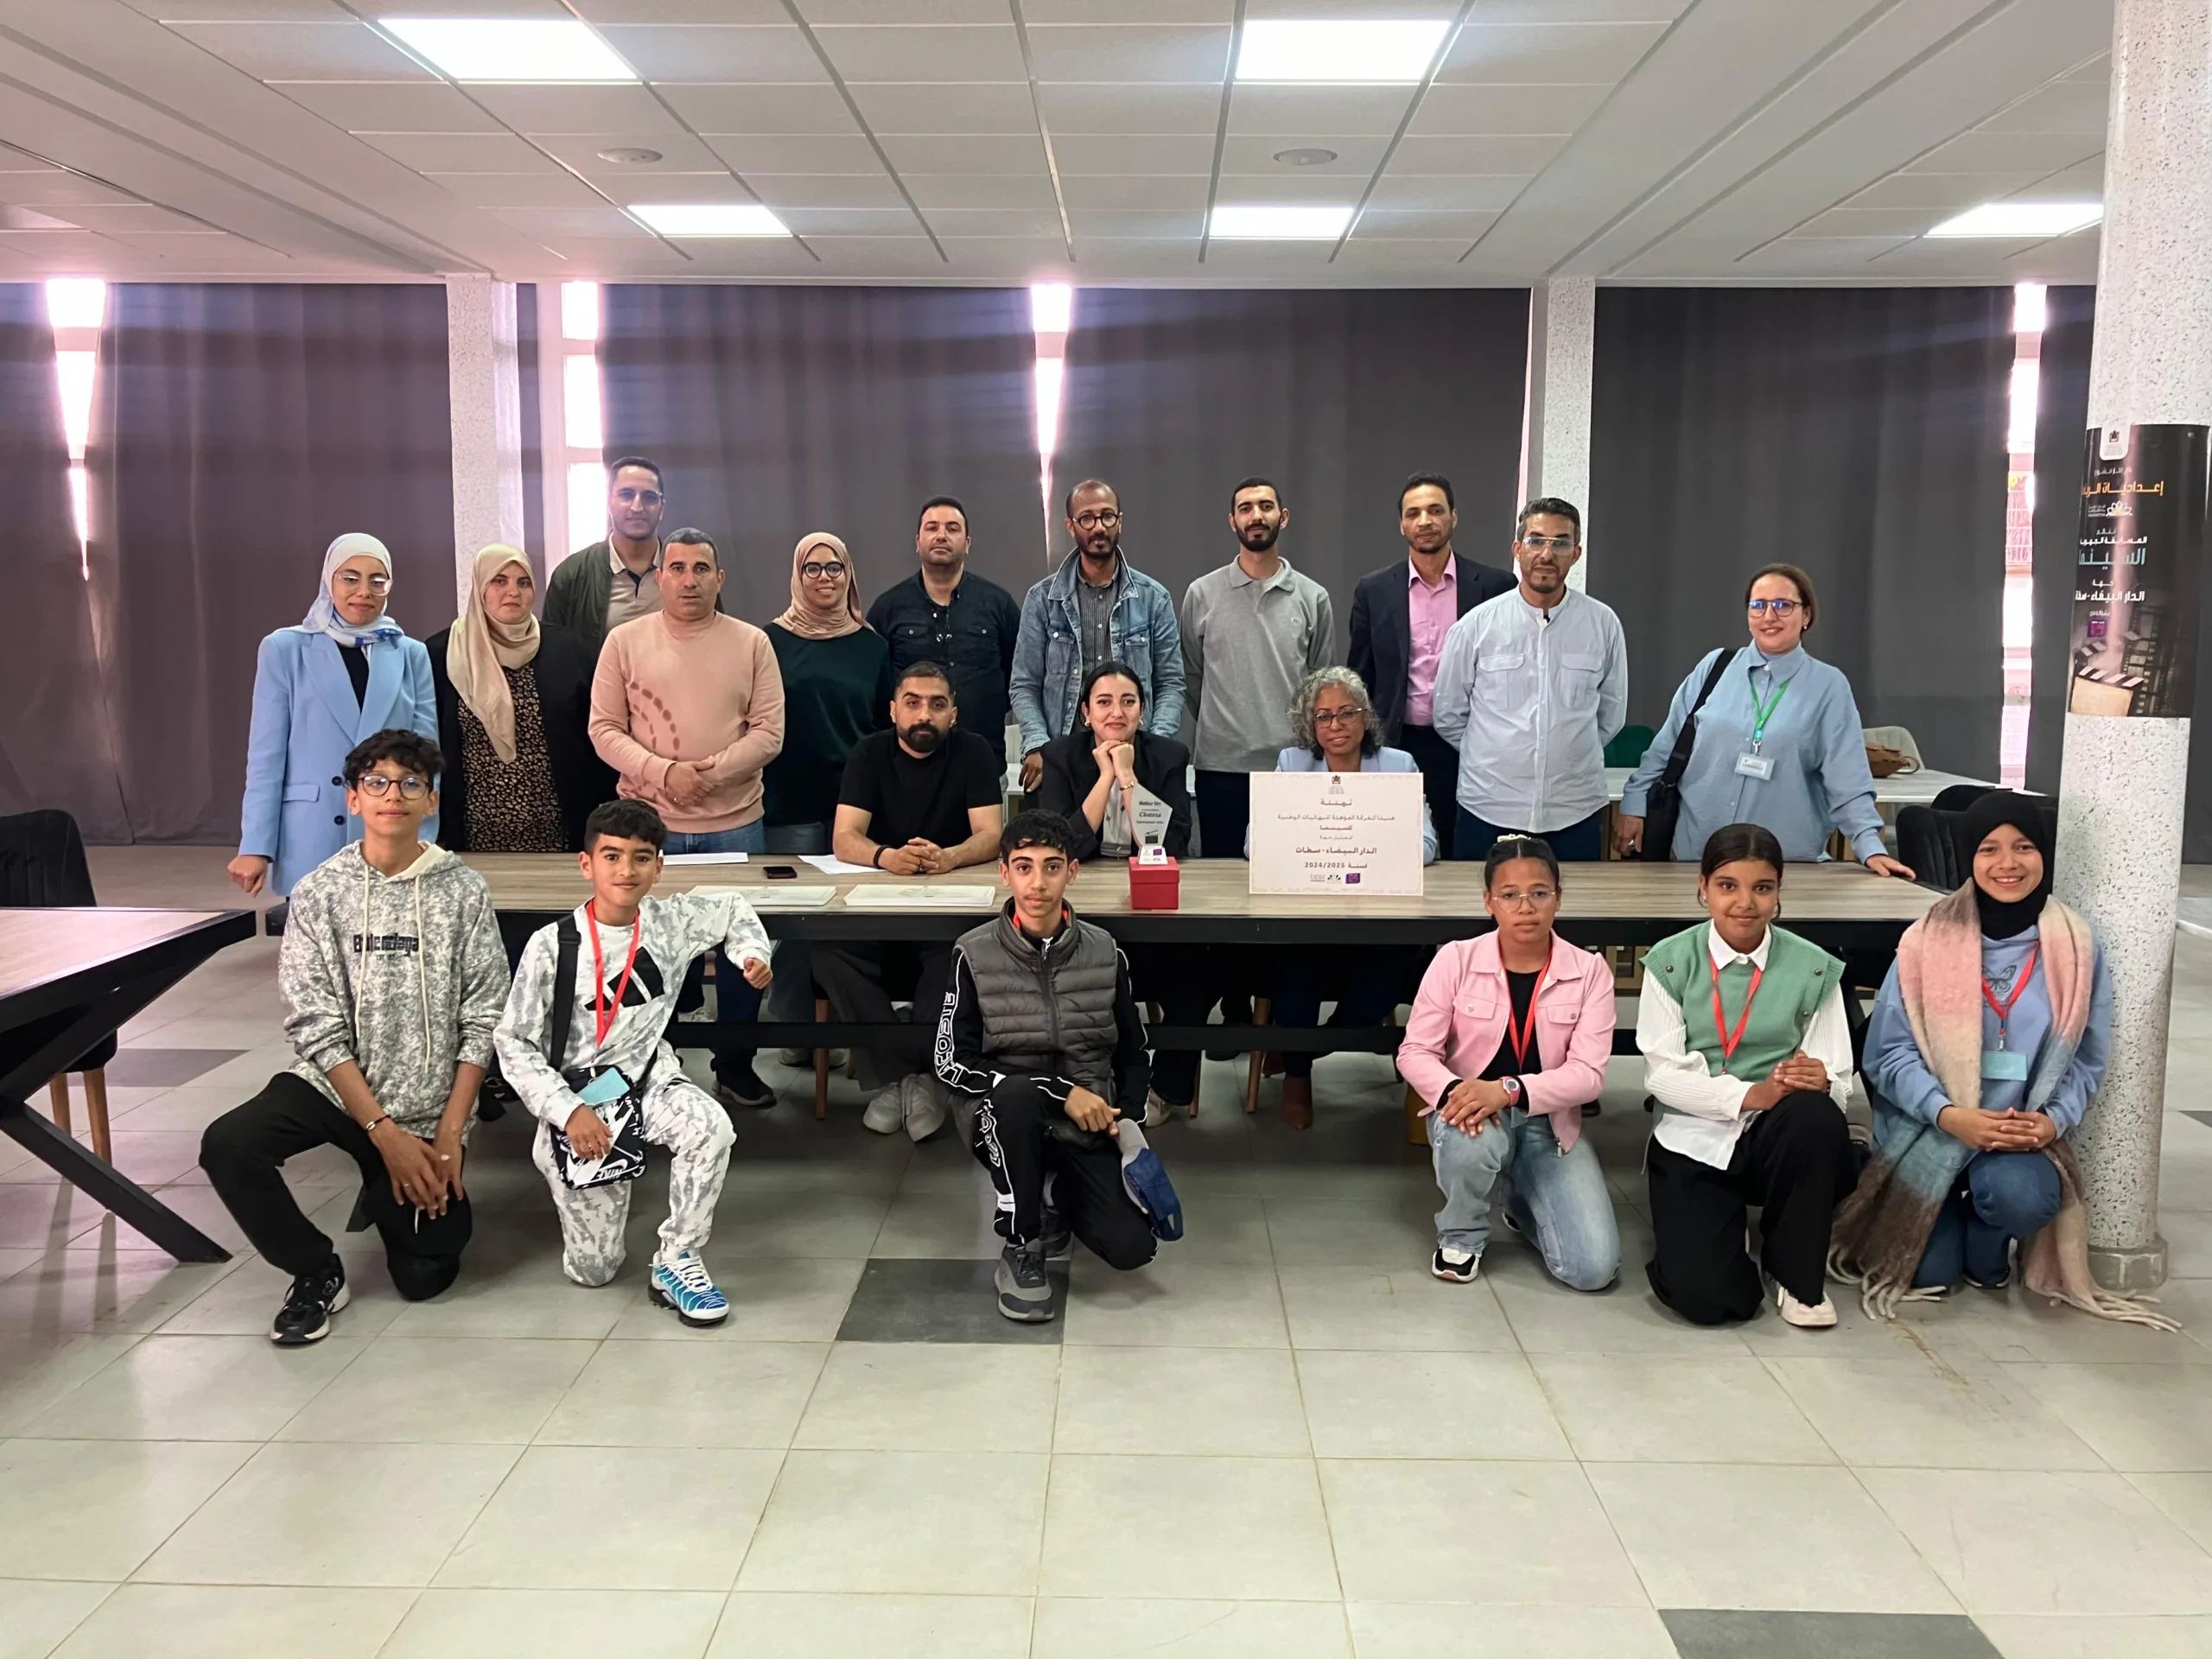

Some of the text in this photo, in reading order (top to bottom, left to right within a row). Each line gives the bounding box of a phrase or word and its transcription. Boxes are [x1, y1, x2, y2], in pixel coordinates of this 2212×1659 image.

[2101, 480, 2164, 497] إعداديات
[1320, 798, 1352, 808] تهنئة
[1325, 847, 1358, 855] البيضاء
[1359, 847, 1377, 855] الدار
